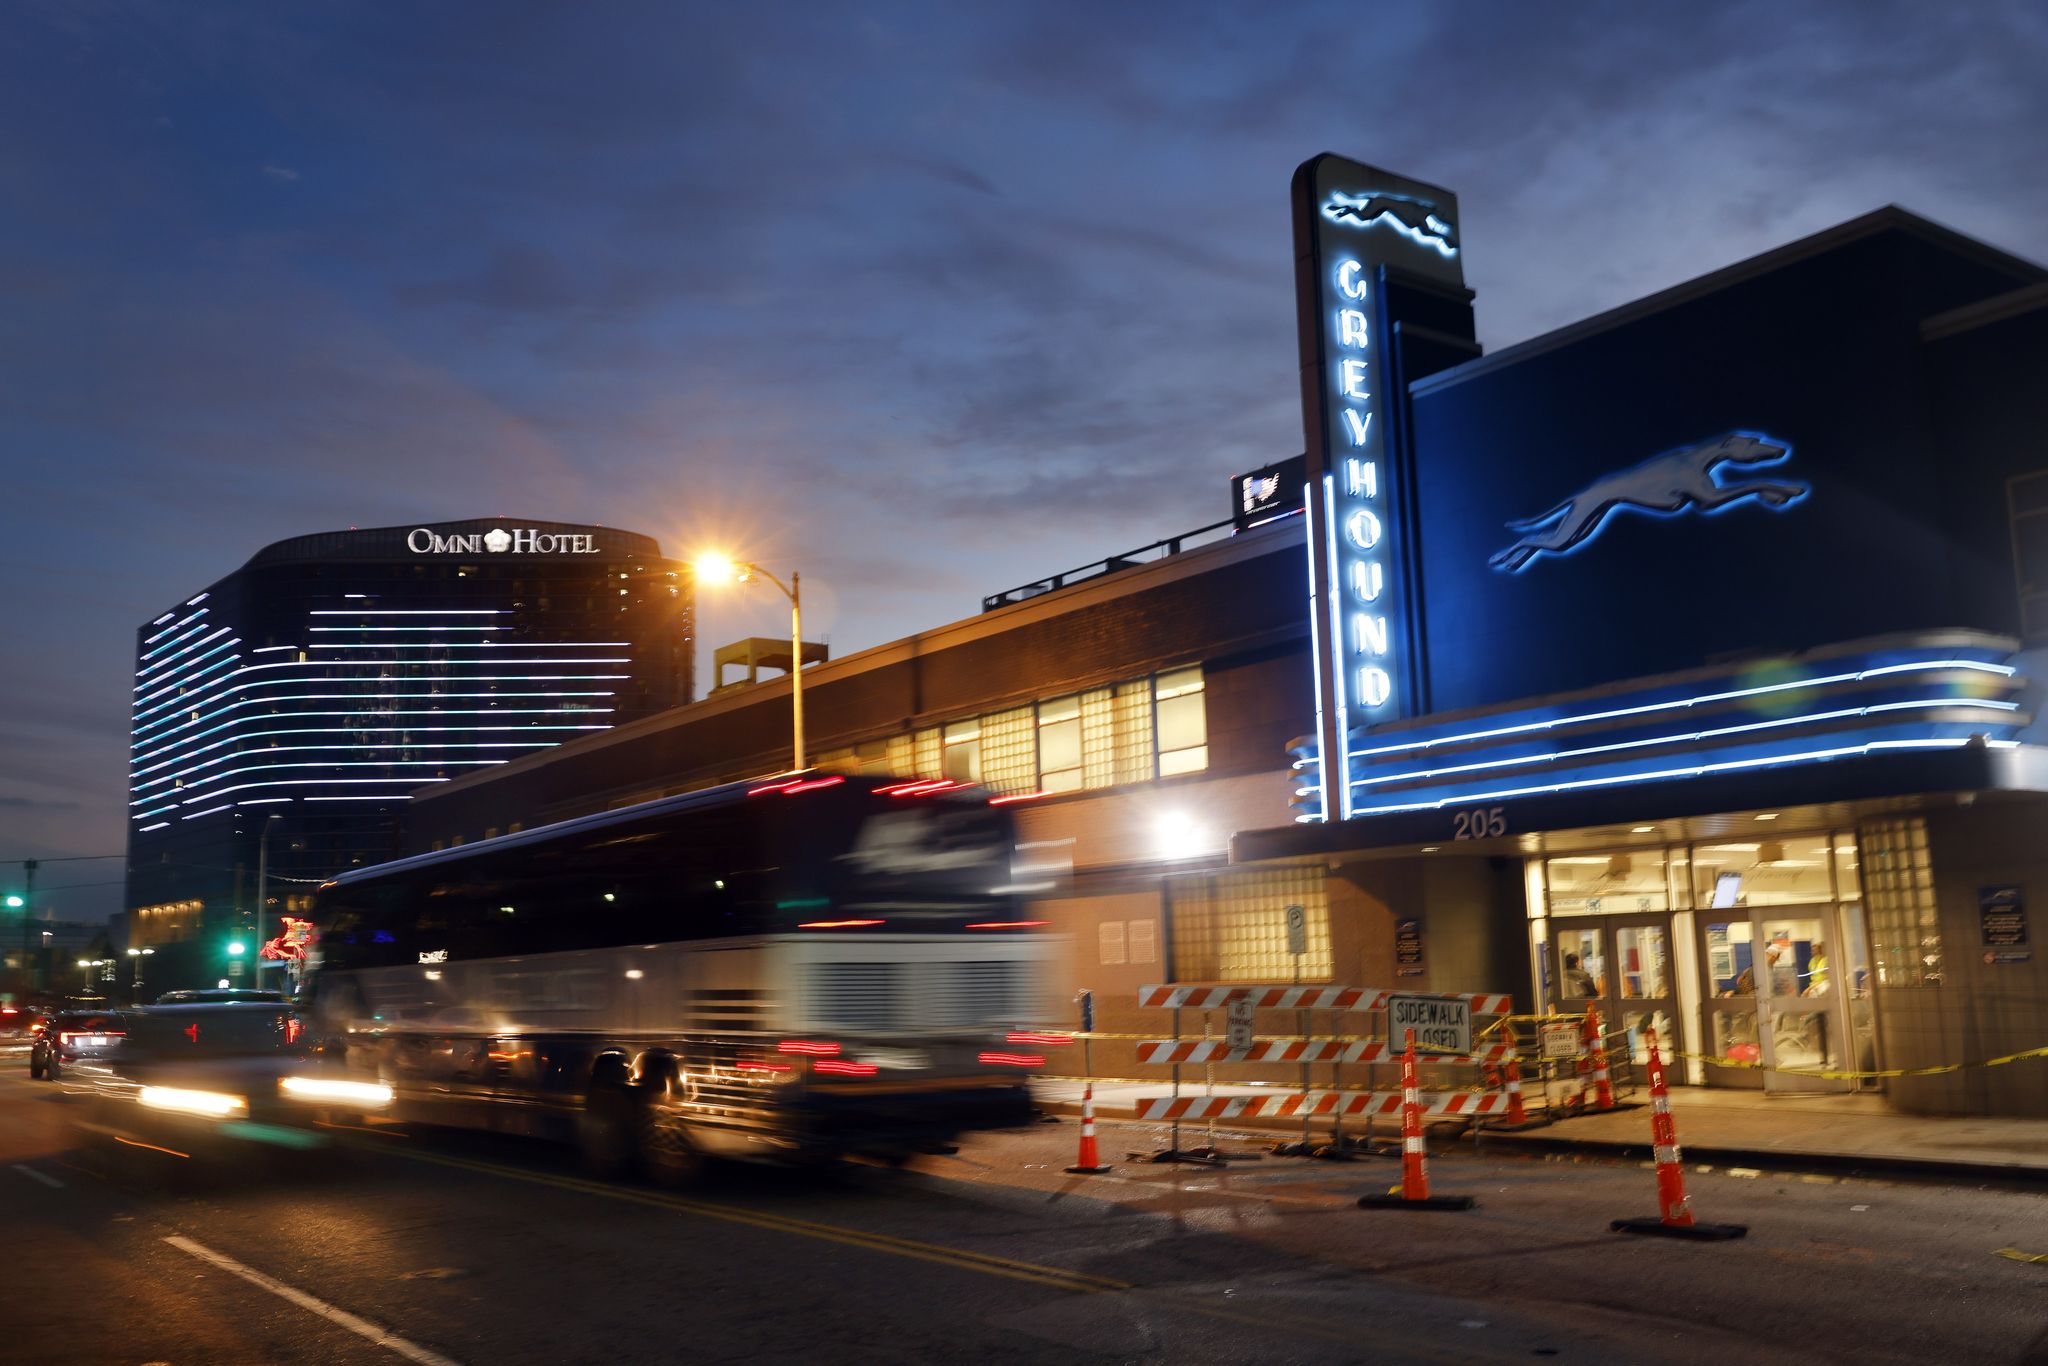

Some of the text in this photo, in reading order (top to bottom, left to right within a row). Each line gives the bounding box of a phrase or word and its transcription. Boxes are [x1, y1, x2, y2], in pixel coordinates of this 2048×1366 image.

[1336, 257, 1391, 709] GREYHOUND
[407, 528, 600, 553] OMNI HOTEL
[1453, 806, 1507, 842] 205
[1396, 1001, 1464, 1026] SIDEWALK
